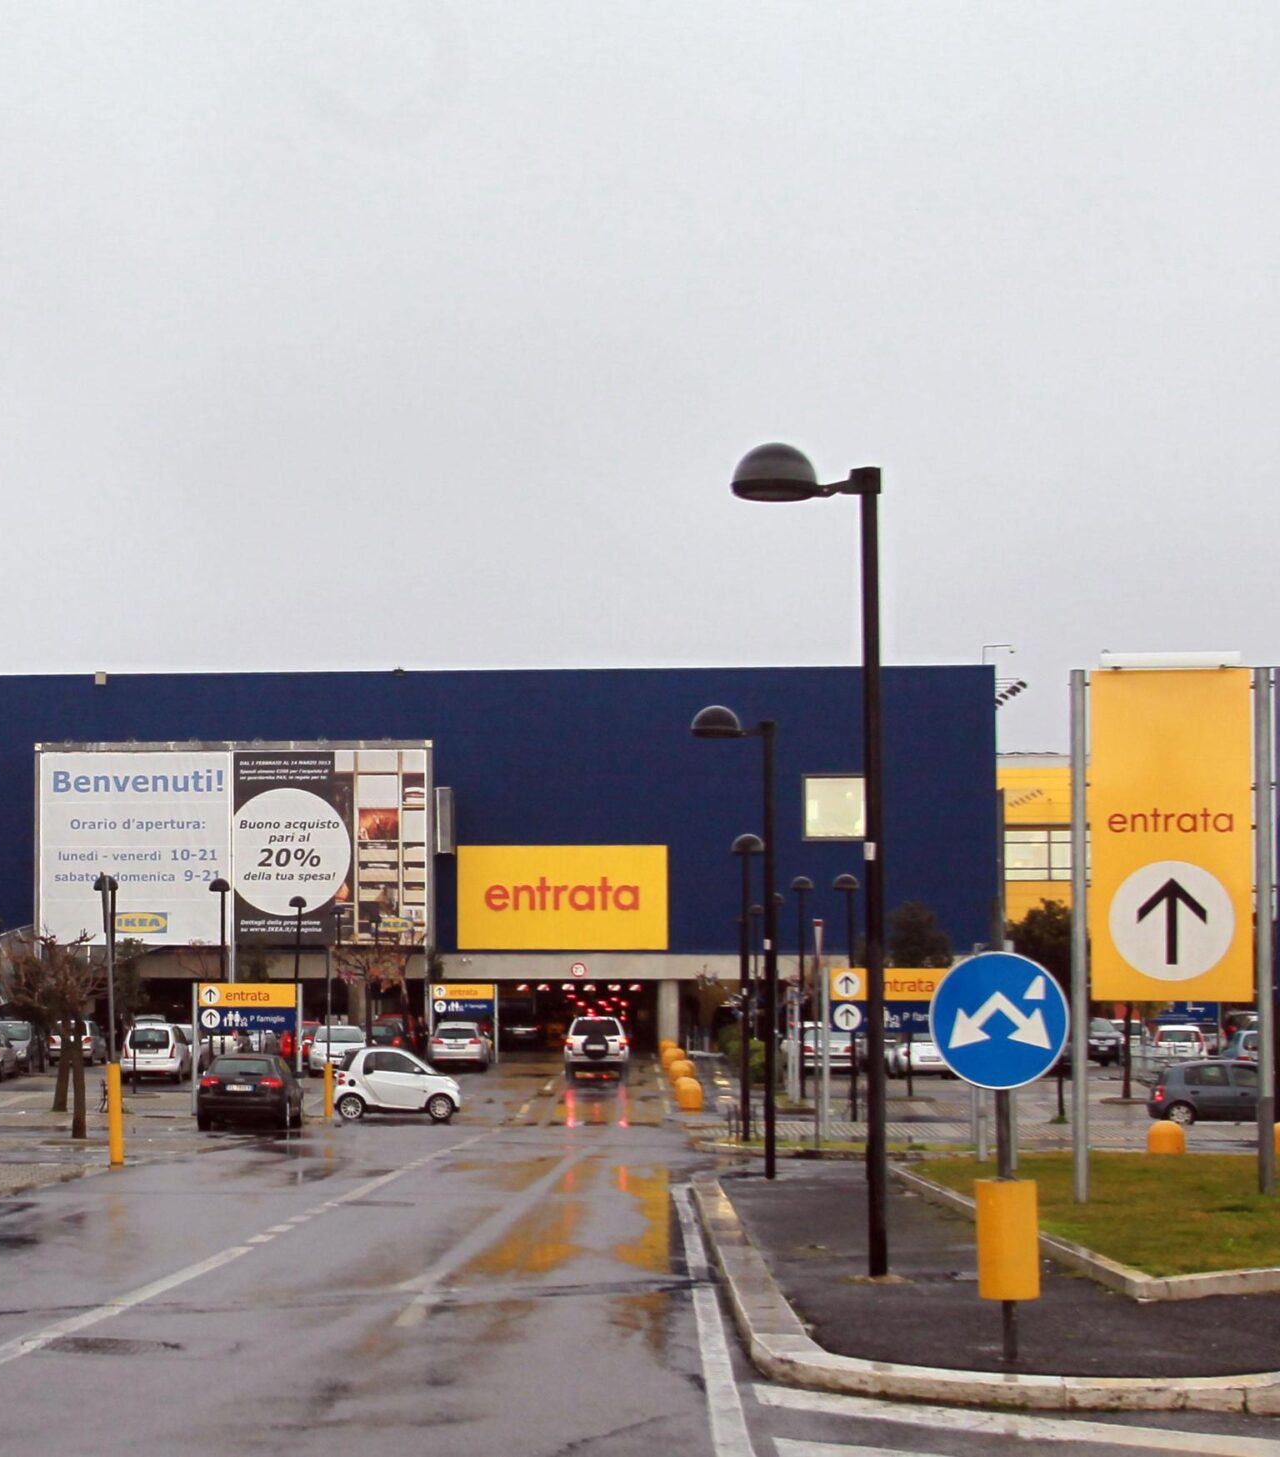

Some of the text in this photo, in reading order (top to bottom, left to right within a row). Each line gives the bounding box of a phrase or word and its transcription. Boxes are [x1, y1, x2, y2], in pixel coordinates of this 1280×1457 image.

[52, 769, 224, 793] Benvenuti!
[70, 818, 206, 832] Orario d'apertura:
[240, 820, 340, 831] Buono acquisto
[1108, 808, 1235, 833] entrata
[268, 832, 311, 844] pari al
[171, 849, 217, 861] 10-21
[257, 848, 321, 867] 20%
[54, 869, 219, 882] sabato domenica 9-21
[243, 872, 336, 882] della tua spesa!
[484, 877, 640, 911] entrata
[116, 918, 160, 927] IKEA
[883, 978, 935, 993] ntrata
[225, 991, 270, 1001] entrata
[256, 1015, 286, 1024] famiglie
